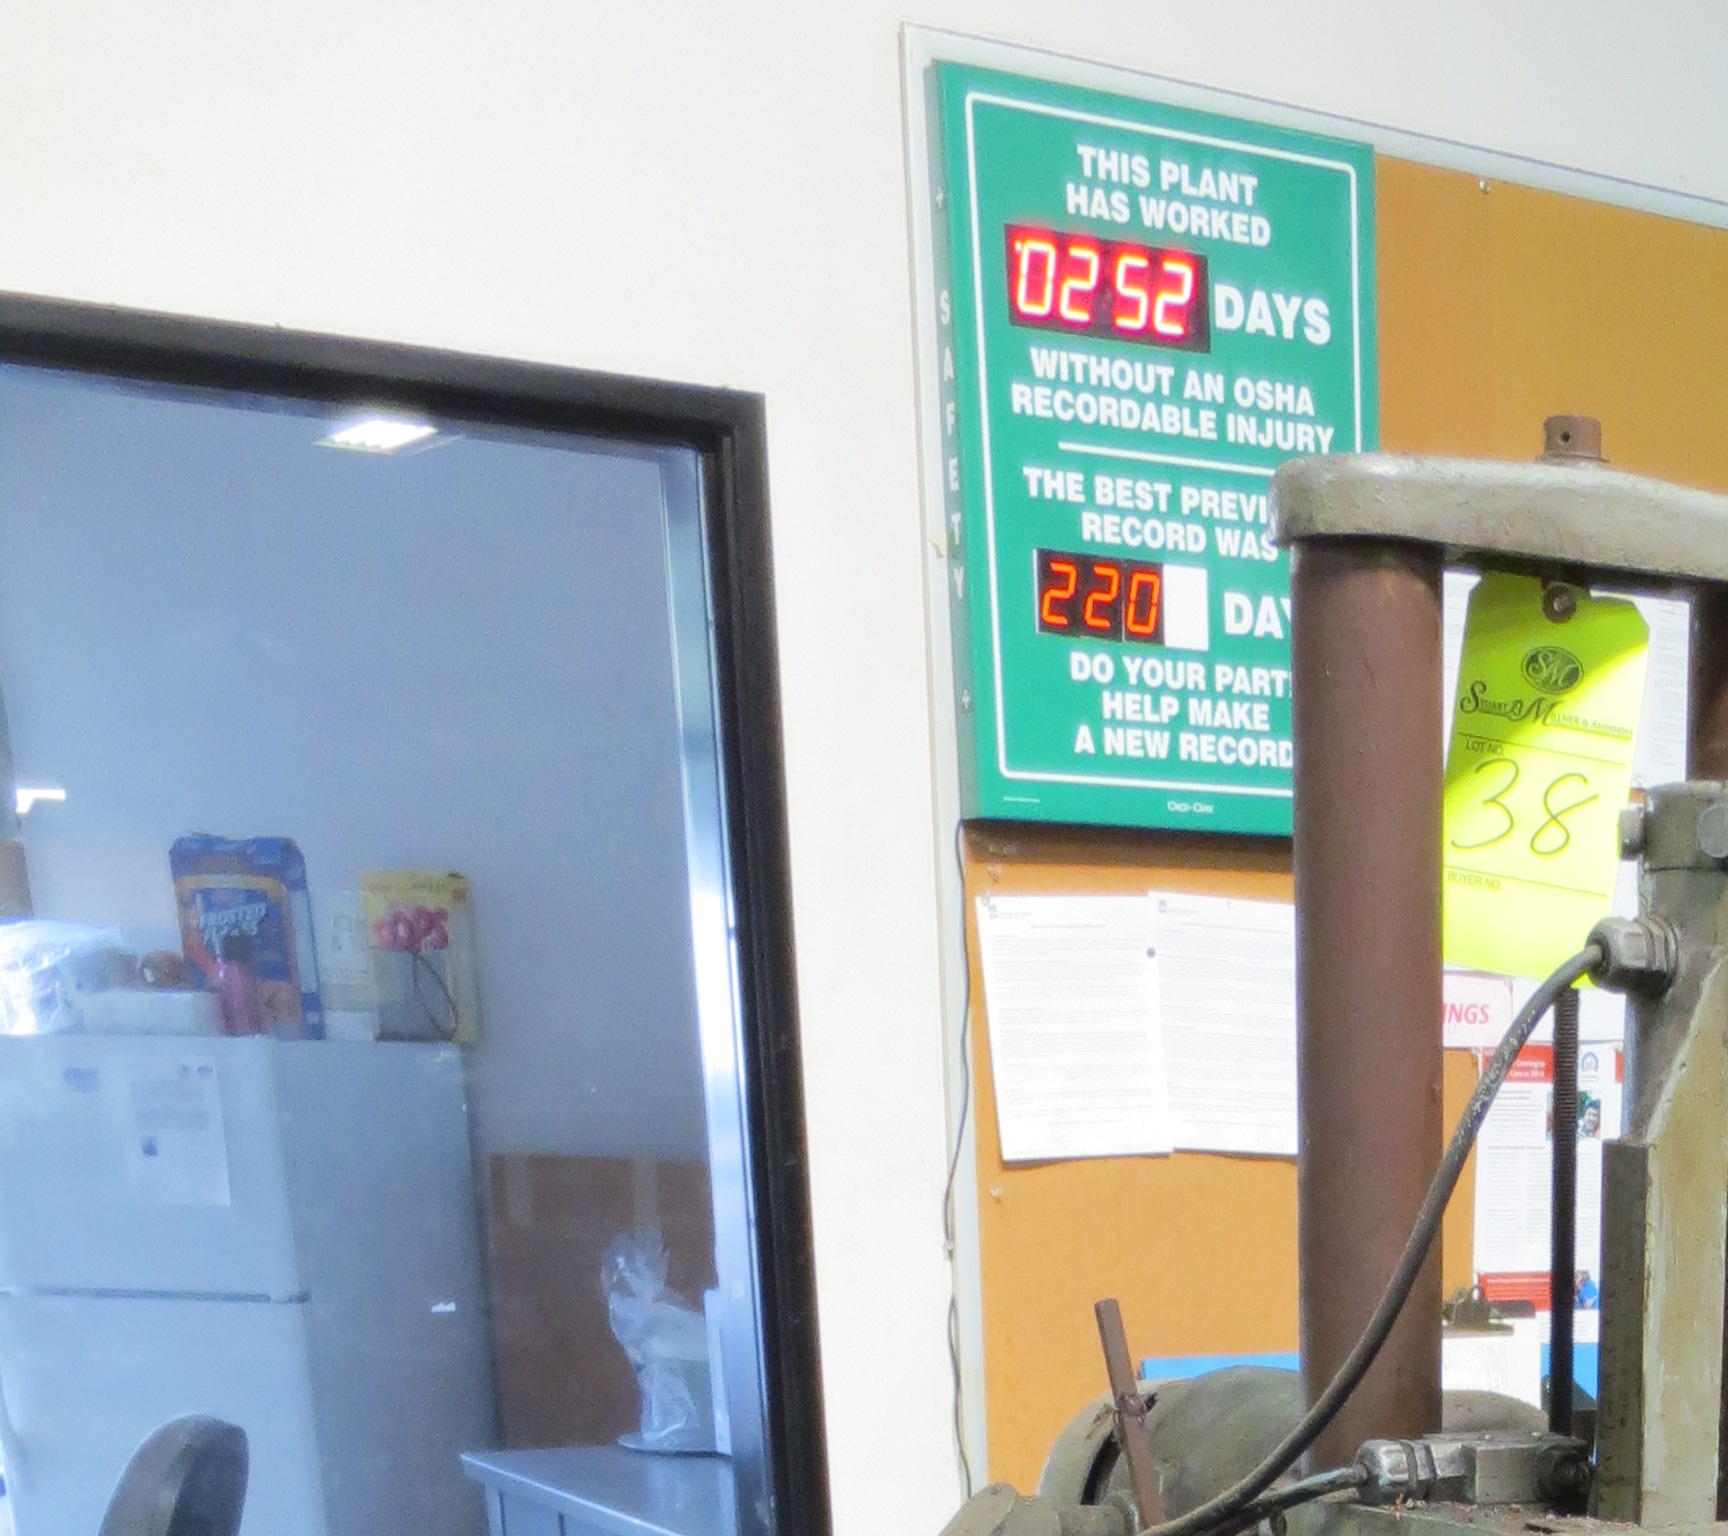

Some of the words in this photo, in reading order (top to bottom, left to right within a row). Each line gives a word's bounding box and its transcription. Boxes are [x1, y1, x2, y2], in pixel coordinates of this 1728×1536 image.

[1076, 143, 1150, 188] THIS
[1160, 160, 1258, 206] PLANT
[1066, 183, 1130, 224] HAS
[1139, 196, 1272, 247] WORKED
[1016, 238, 1195, 337] 0252
[1213, 283, 1332, 346] DAYS
[1029, 347, 1175, 396] WITHOUT
[1183, 372, 1225, 405] AN
[1234, 377, 1316, 417] OSHA
[940, 289, 966, 599] SAFETY
[1011, 383, 1218, 441] RECORDABLE
[1226, 413, 1335, 455] INJURY
[1022, 466, 1085, 503] THE
[1095, 475, 1172, 514] BEST
[1181, 485, 1269, 525] PREVI
[1081, 512, 1207, 554] RECORD
[1214, 527, 1279, 563] WAS
[1041, 562, 1162, 636] 220
[1223, 592, 1294, 640] DA
[1069, 652, 1114, 683] DO
[1123, 656, 1207, 694] YOUR
[1102, 689, 1180, 725] HELP
[1188, 699, 1271, 733] MAKE
[1073, 724, 1096, 755] A
[1103, 727, 1170, 761] NEW
[1178, 733, 1294, 769] RECORD
[1465, 738, 1485, 753] LOT
[1450, 757, 1600, 857] 38
[1447, 869, 1483, 886] BUYER
